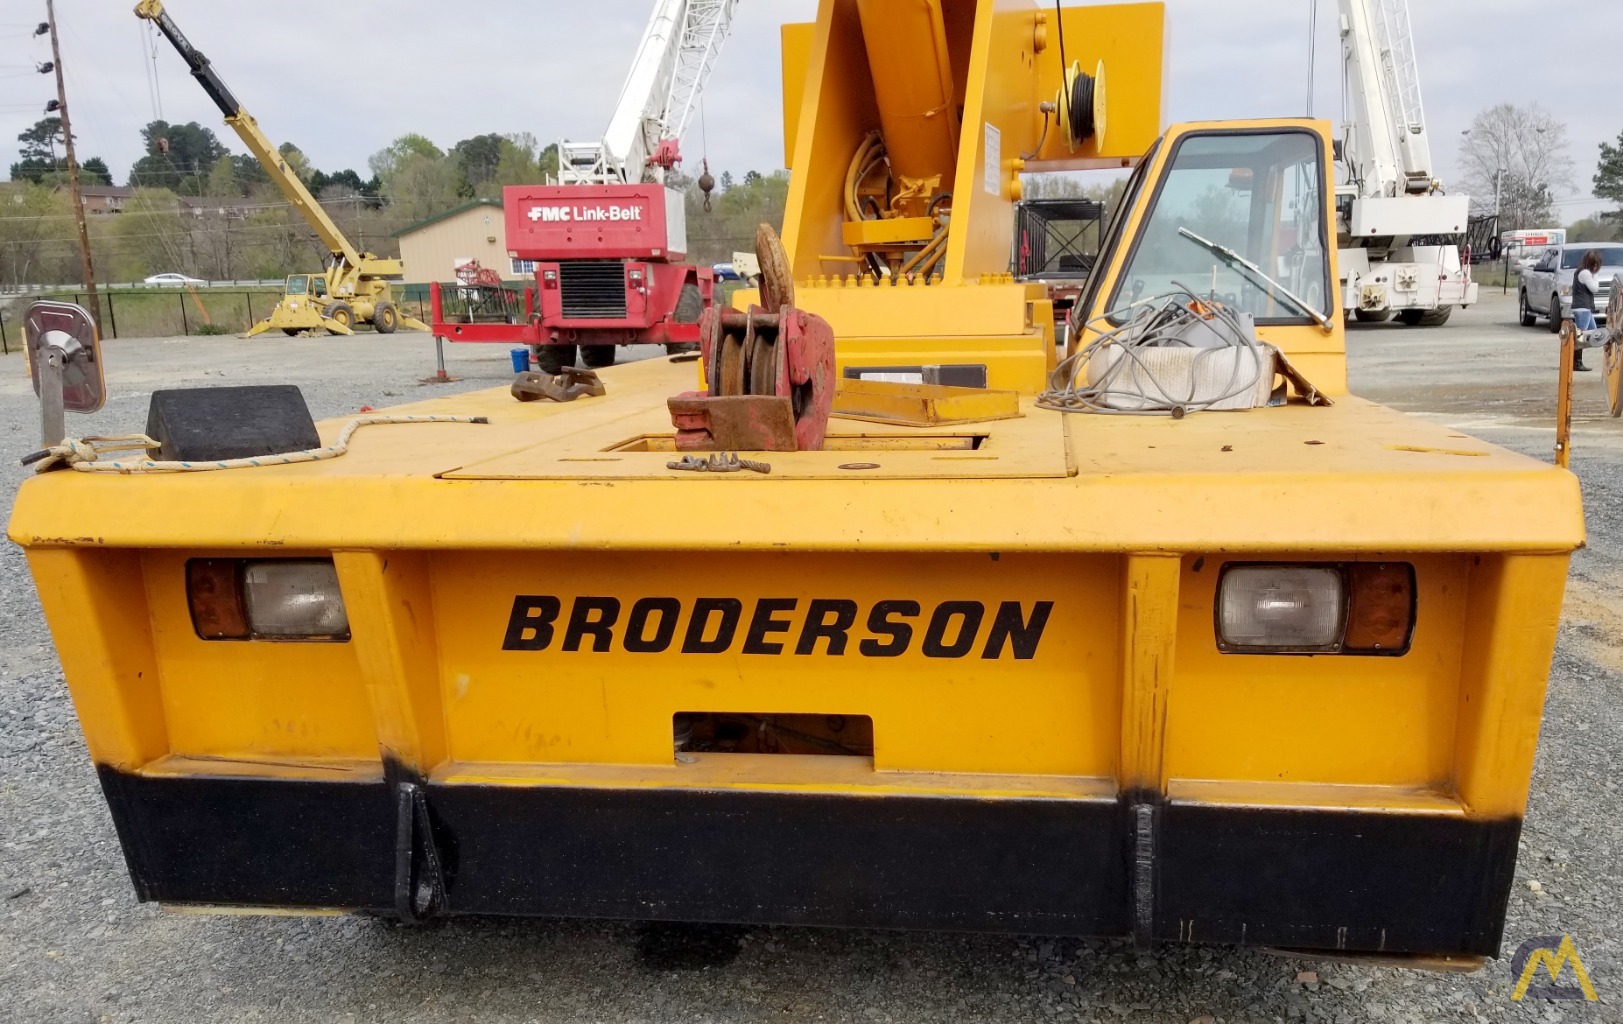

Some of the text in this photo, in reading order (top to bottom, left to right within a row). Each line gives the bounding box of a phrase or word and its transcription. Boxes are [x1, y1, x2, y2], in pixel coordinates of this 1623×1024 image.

[528, 205, 642, 221] FMC Link-Belt
[502, 595, 1054, 660] BRODERSON
